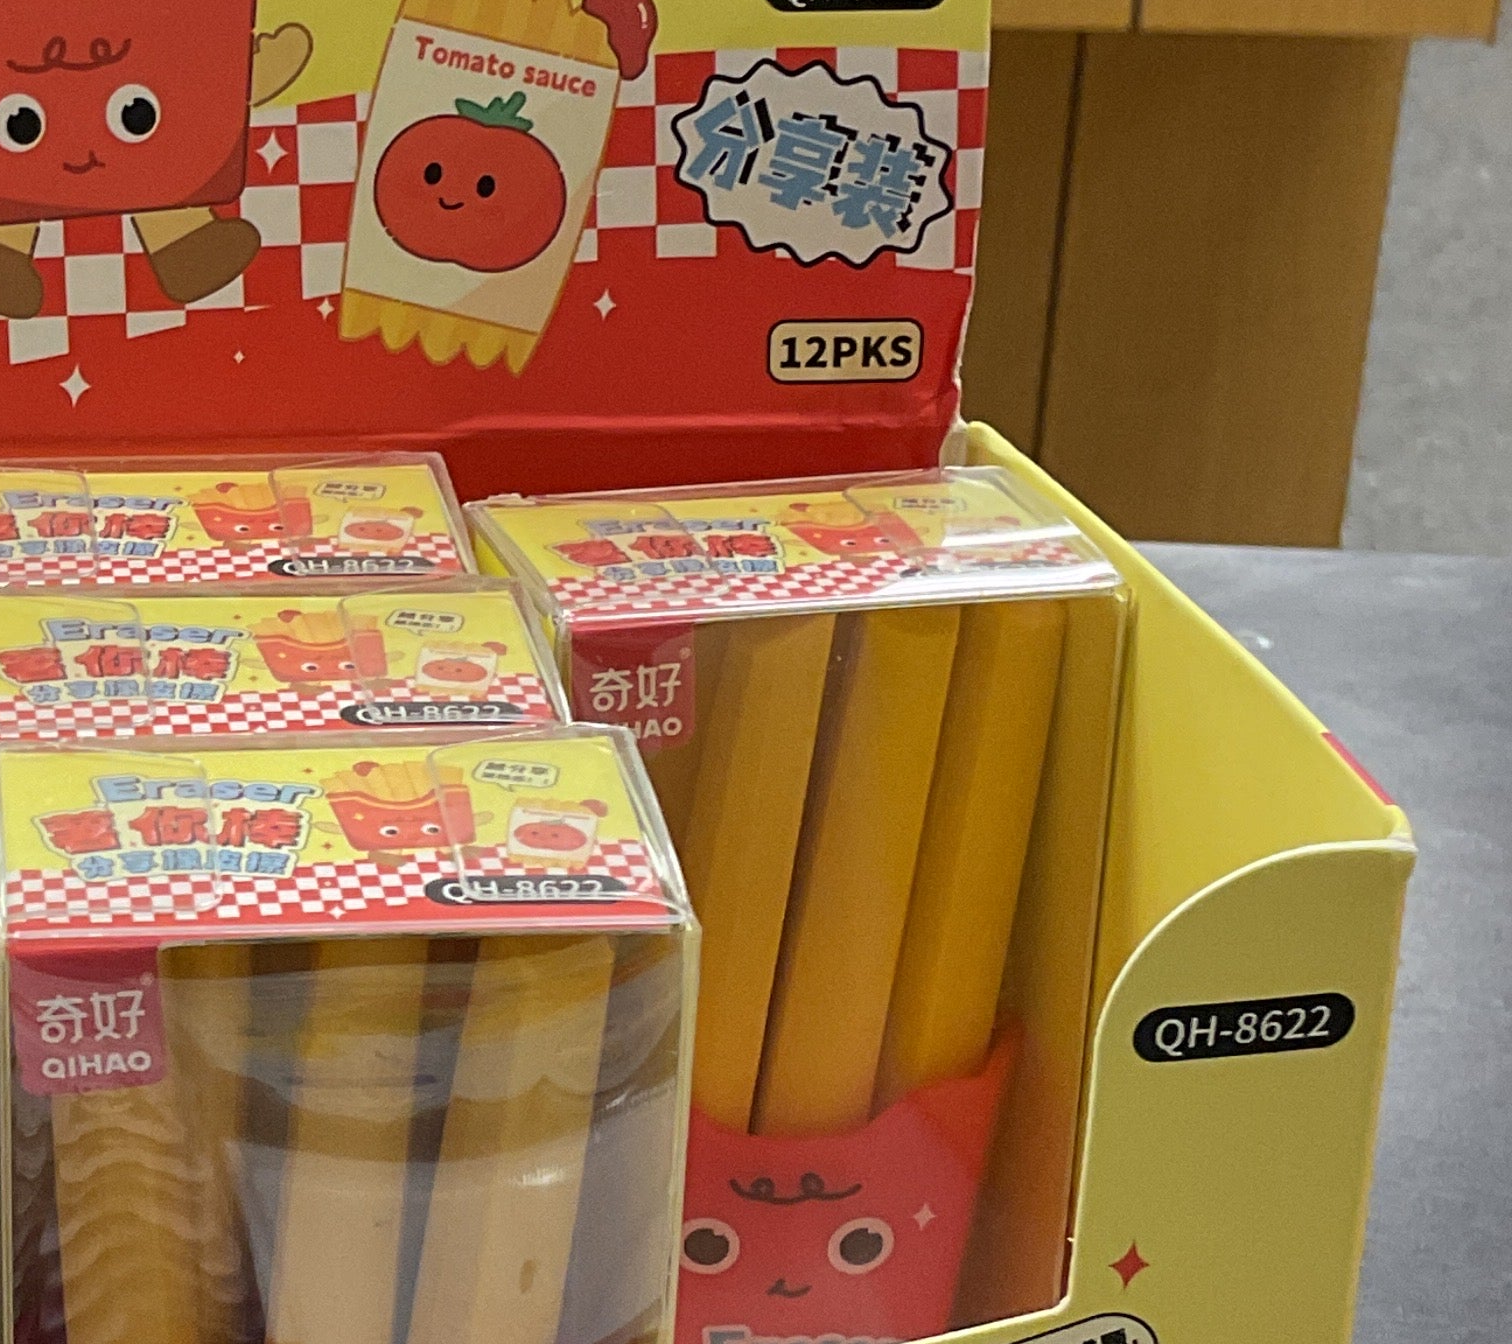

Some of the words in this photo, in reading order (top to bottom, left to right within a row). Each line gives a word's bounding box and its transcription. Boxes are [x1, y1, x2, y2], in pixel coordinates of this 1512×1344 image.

[414, 36, 516, 82] Tomato
[522, 65, 597, 98] sauce
[686, 90, 935, 240] 分享装
[778, 335, 913, 368] 12PKS
[49, 619, 243, 644] Eraser
[589, 663, 682, 712] 奇好
[615, 717, 682, 739] HAO
[98, 776, 316, 803] Eraser
[36, 990, 145, 1043] 奇好
[1155, 1005, 1332, 1057] QH-8622
[42, 1050, 151, 1078] QIHAO
